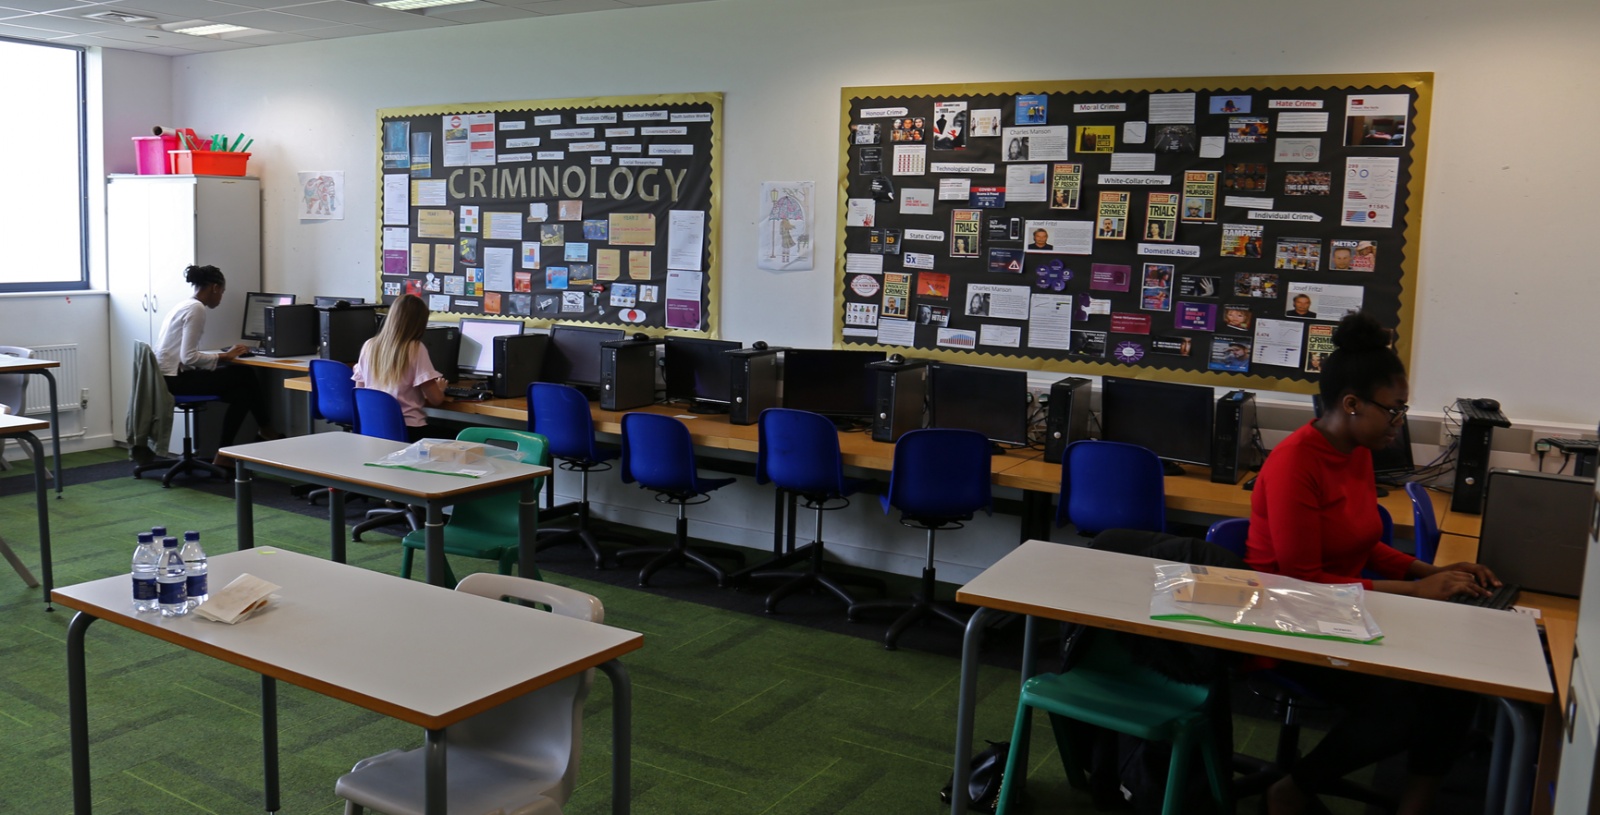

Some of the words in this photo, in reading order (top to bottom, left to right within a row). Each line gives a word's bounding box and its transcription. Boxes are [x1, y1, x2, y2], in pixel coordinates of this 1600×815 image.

[449, 165, 687, 202] CRIMINOLOGY
[1149, 206, 1176, 217] TRIALS
[955, 222, 978, 233] TRIALS
[1223, 229, 1262, 237] RAMPAGE
[1333, 240, 1358, 248] METRO
[1144, 247, 1174, 255] Domestic
[1176, 248, 1197, 256] Abuse
[905, 254, 916, 264] 5x
